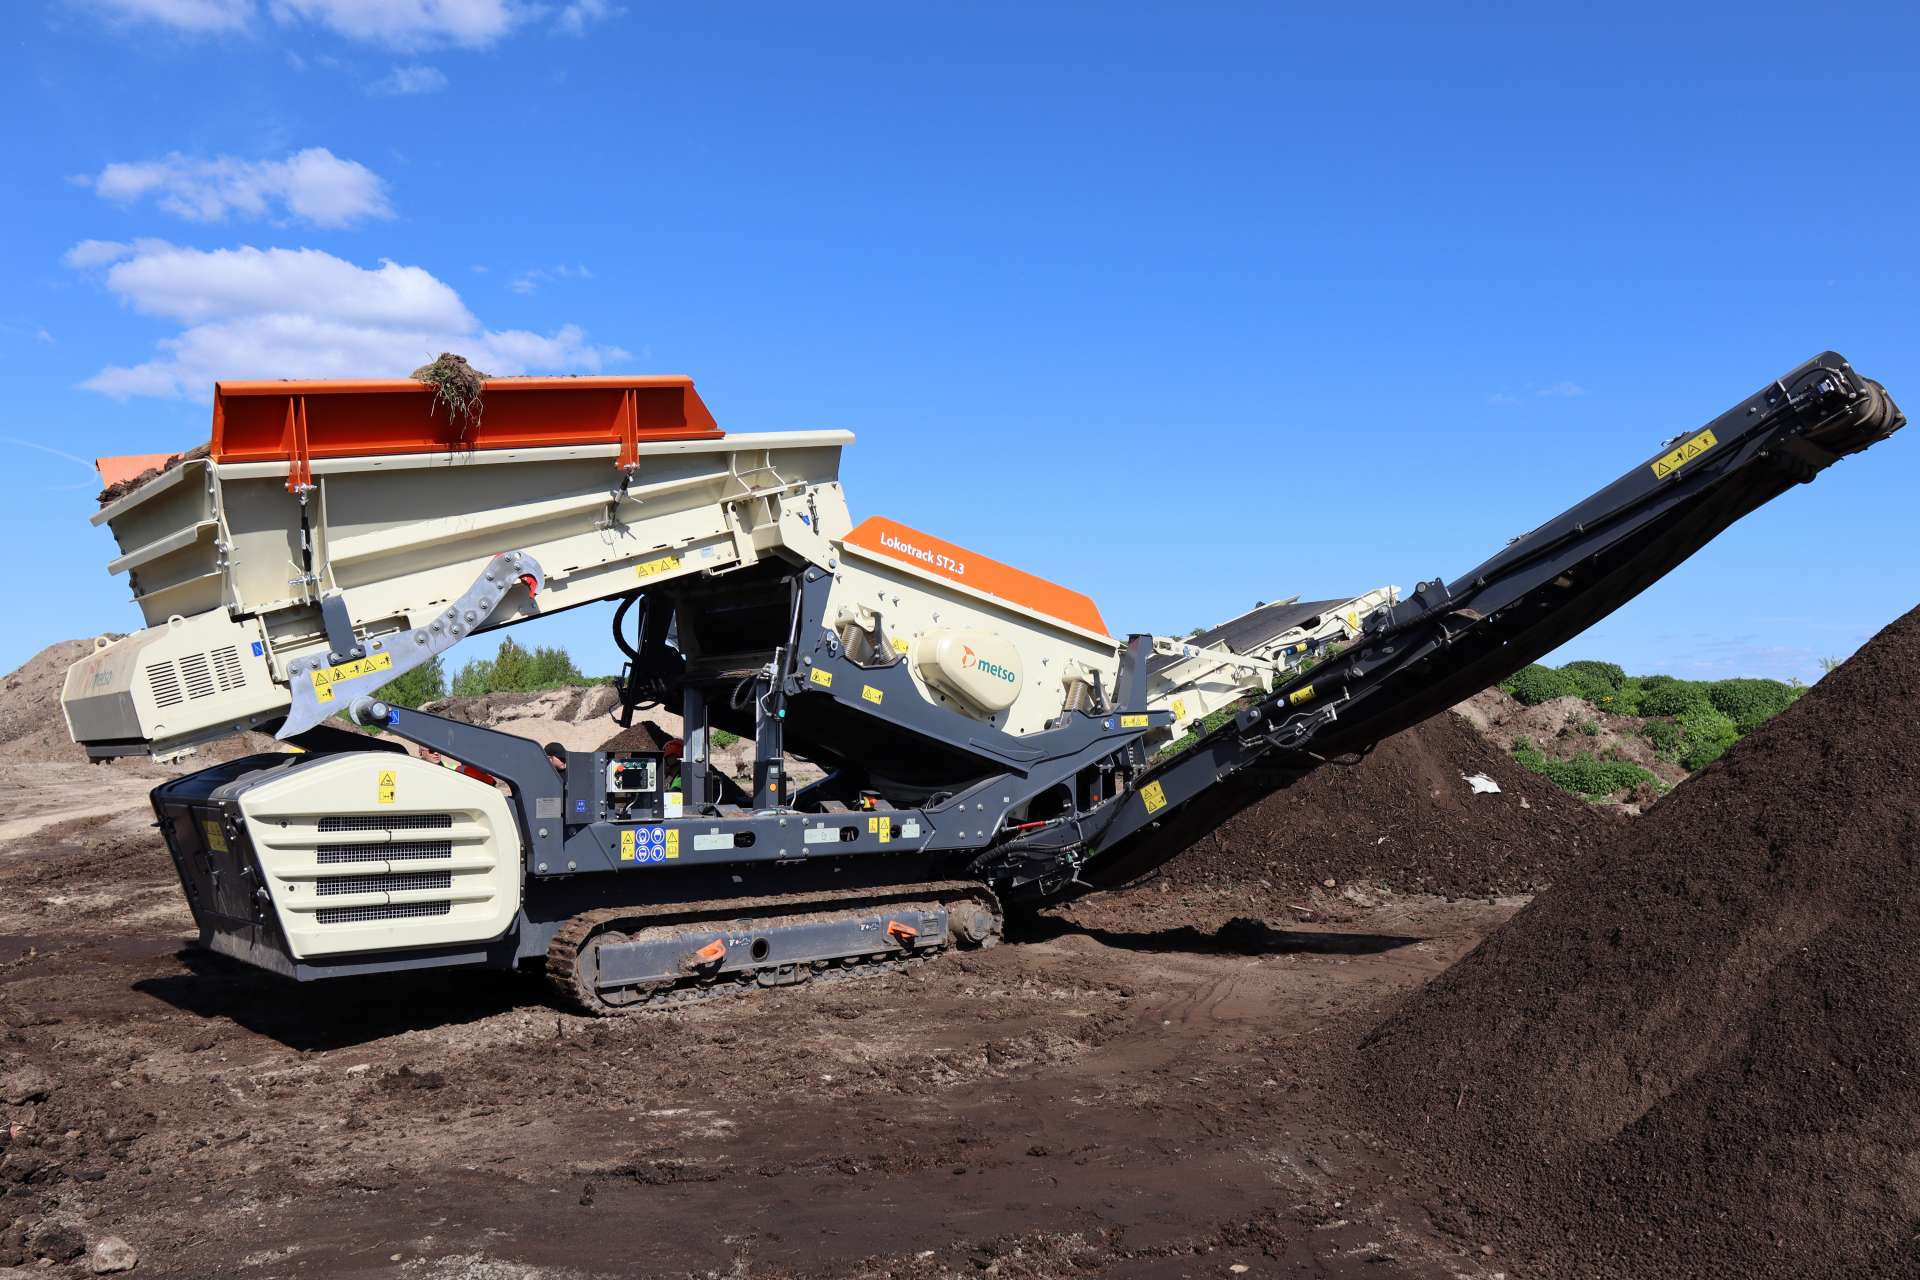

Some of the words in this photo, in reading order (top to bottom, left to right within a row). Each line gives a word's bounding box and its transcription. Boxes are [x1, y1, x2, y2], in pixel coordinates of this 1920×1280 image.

[880, 531, 934, 564] Lokotrack
[936, 554, 965, 575] ST2.3
[978, 659, 1015, 683] metso
